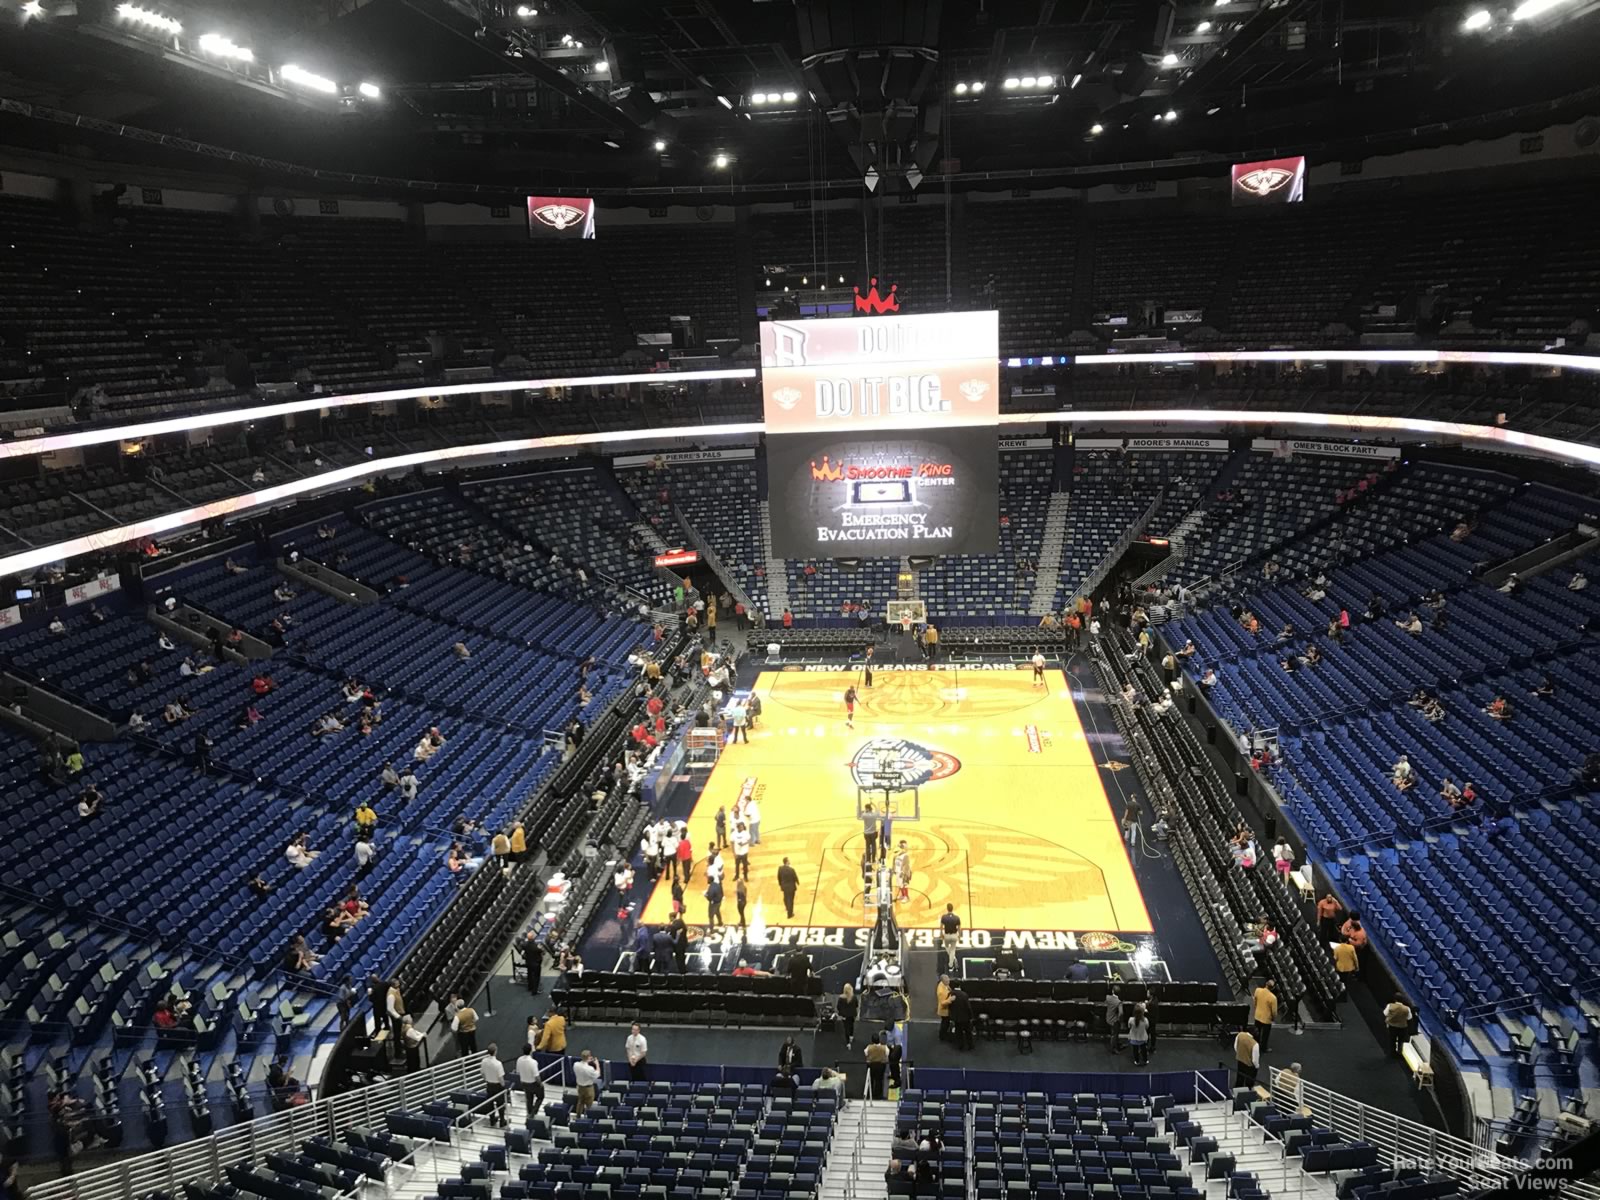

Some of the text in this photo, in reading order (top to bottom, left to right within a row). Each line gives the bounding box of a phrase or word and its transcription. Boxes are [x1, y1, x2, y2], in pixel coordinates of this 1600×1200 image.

[815, 374, 951, 417] DO IT BIG.
[1293, 442, 1379, 454] OMER'S BLOCK PARTY
[917, 477, 955, 486] CENTER
[912, 525, 953, 539] PLAN
[804, 664, 846, 672] NEW
[934, 663, 1018, 671] PELICANS
[1002, 930, 1079, 950] NEW
